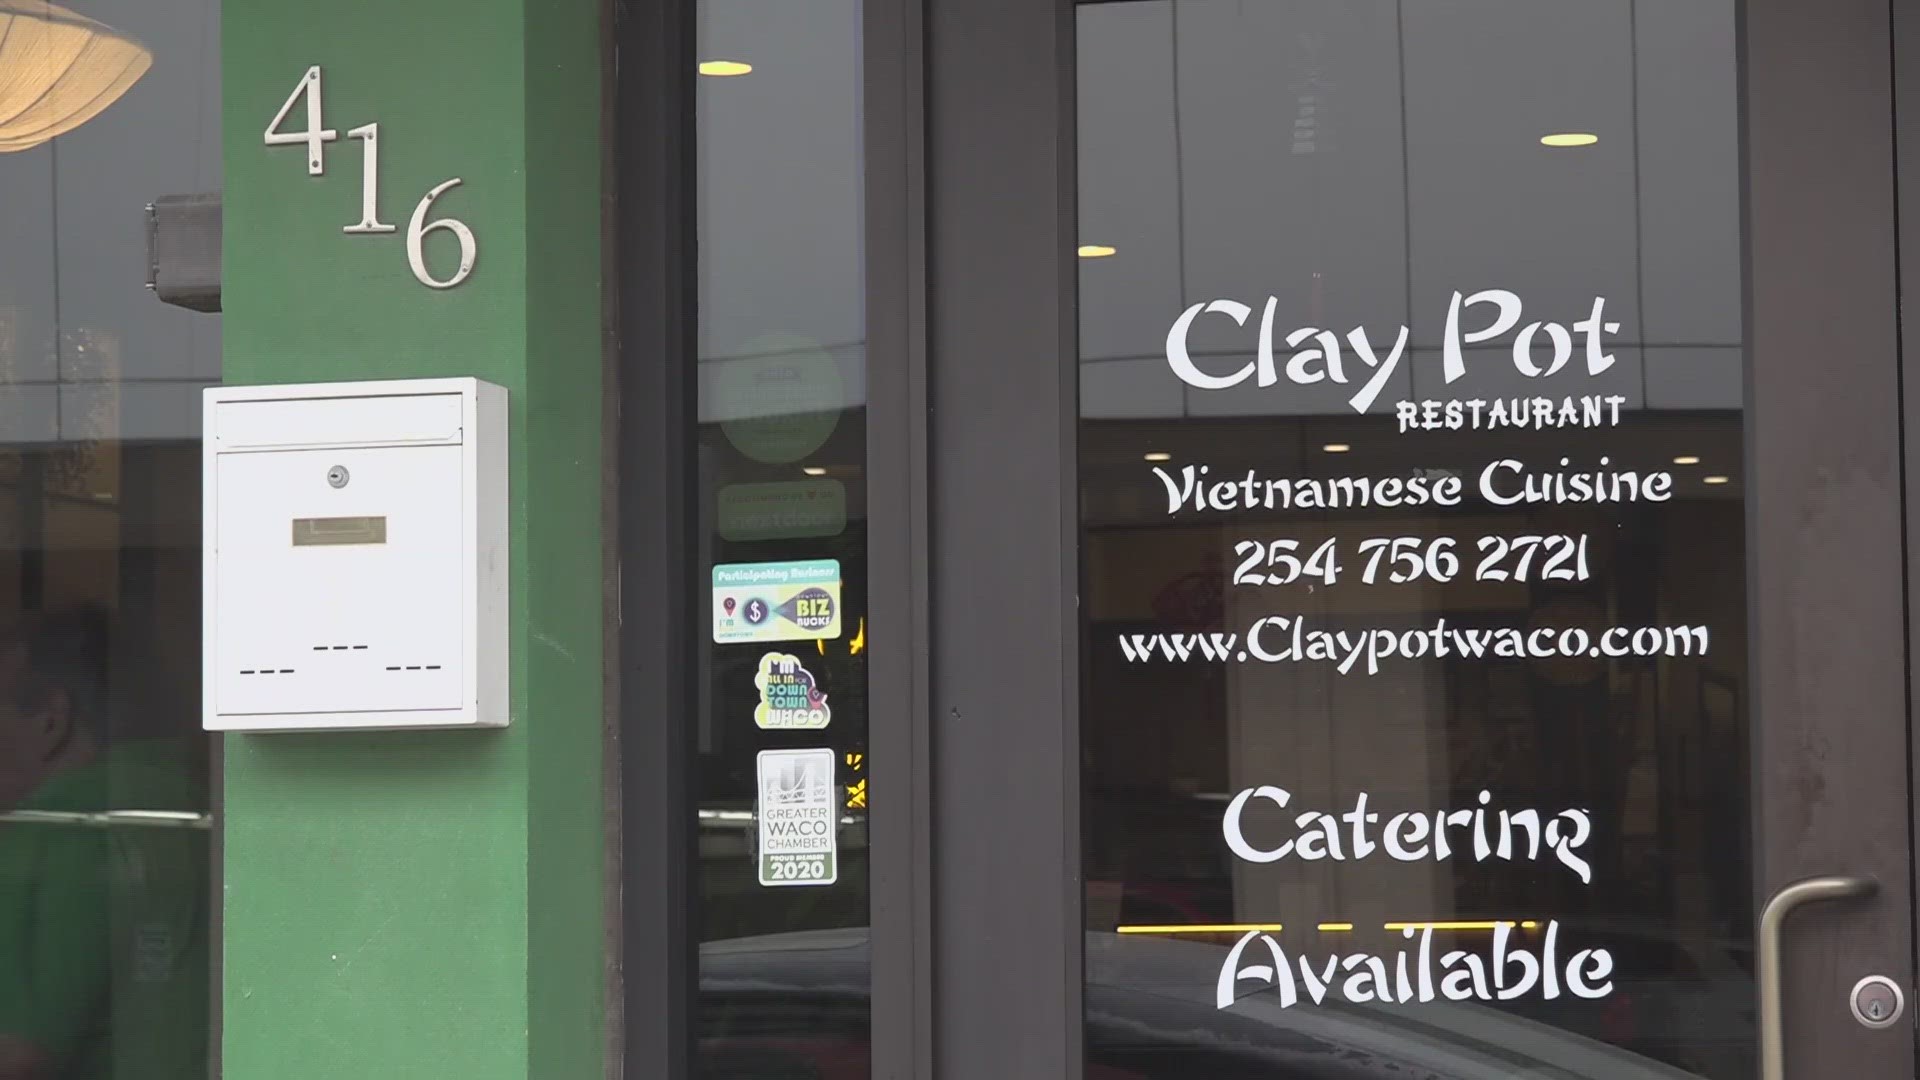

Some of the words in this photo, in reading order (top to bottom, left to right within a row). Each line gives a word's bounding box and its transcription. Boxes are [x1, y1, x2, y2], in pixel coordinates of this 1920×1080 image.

[264, 65, 476, 290] 416
[1166, 295, 1409, 415] Clay
[1443, 290, 1620, 384] Pot
[1396, 395, 1625, 433] RESTAURANT
[1153, 465, 1462, 513] Vietnamese
[1480, 457, 1672, 504] Cuisine
[1234, 537, 1342, 585] 254
[1358, 538, 1458, 584] 756
[1476, 534, 1589, 582] 2721
[796, 599, 830, 616] BIZ
[796, 616, 830, 627] BUCKS
[1120, 616, 1708, 675] www.Claypotwaco.com
[767, 684, 807, 695] DOWN
[768, 697, 807, 708] TOWN
[767, 709, 824, 726] WACO
[767, 807, 827, 820] GREATER
[767, 821, 827, 836] WACO
[1223, 786, 1590, 884] Catering
[767, 837, 827, 850] CHAMBER
[770, 861, 825, 879] 2020
[1216, 920, 1613, 1009] Available
